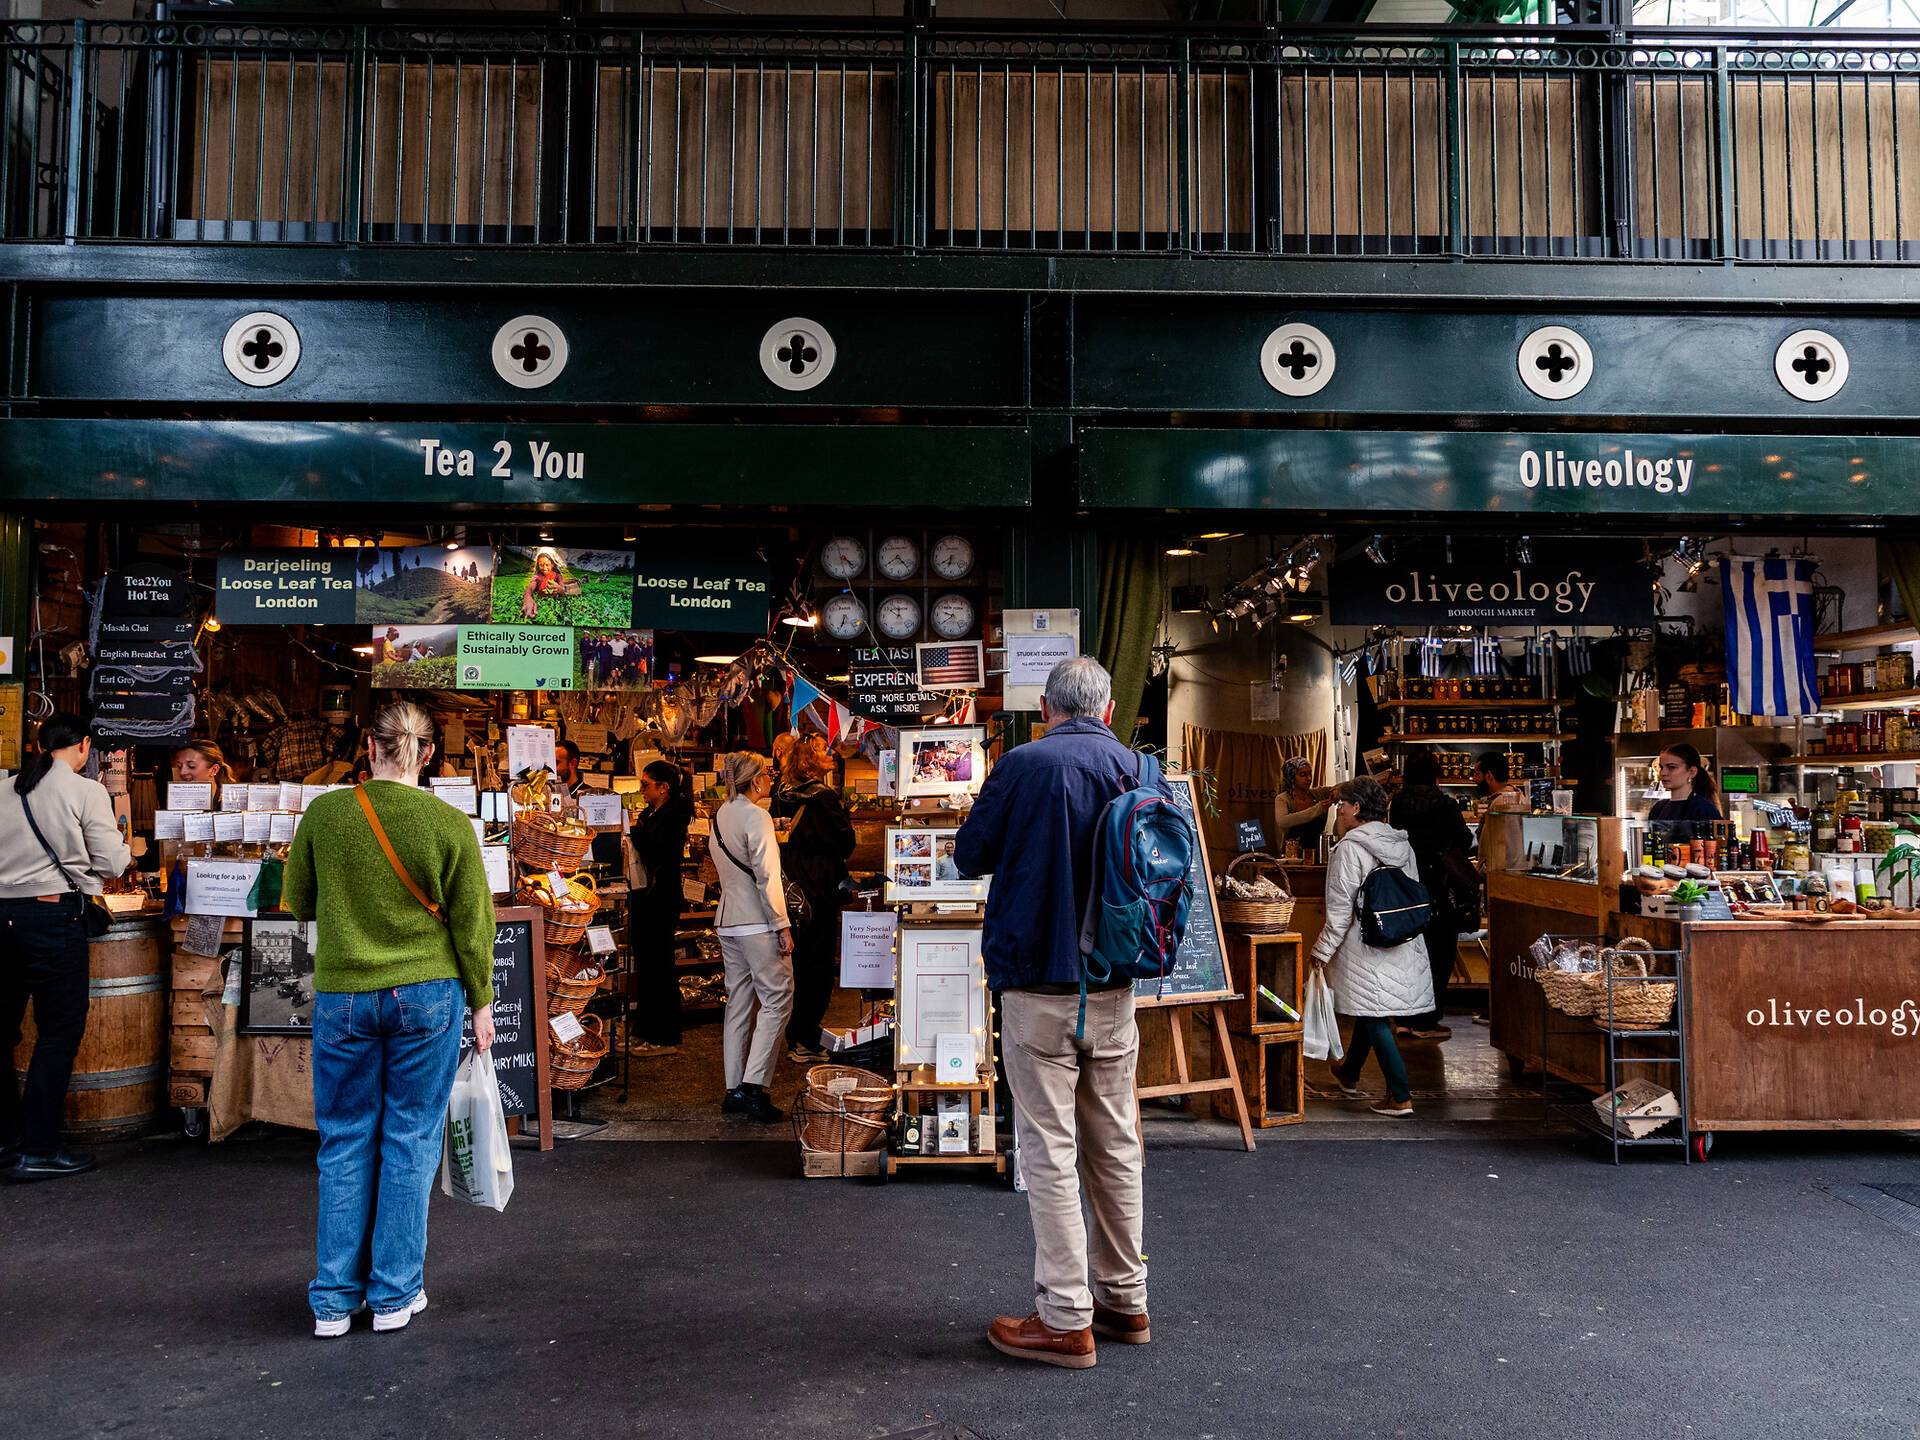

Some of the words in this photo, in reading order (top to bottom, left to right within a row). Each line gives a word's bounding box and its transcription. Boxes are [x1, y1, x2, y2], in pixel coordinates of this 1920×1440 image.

[420, 439, 474, 477] Tea
[491, 440, 513, 478] 2
[529, 441, 585, 479] You
[1519, 449, 1693, 493] Oliveology
[244, 559, 331, 574] Darjeeling
[124, 576, 172, 587] Tea2You
[221, 577, 273, 590] Loose
[278, 577, 317, 590] Leaf
[322, 577, 353, 590] Tea
[637, 574, 688, 588] Loose
[693, 577, 730, 590] Leaf
[735, 579, 766, 592] Tea
[127, 590, 148, 601] Hot
[149, 590, 169, 601] Tea
[1385, 570, 1596, 613] oliveology
[255, 595, 318, 608] London
[670, 594, 732, 609] London
[1448, 609, 1495, 617] BOROUGH
[1497, 608, 1536, 617] MARKET
[102, 623, 130, 632] Masala
[131, 623, 149, 632] Chai
[467, 631, 515, 643] Ethically
[518, 631, 566, 642] Sourced
[100, 649, 130, 660] English
[131, 649, 167, 659] Breakfast
[463, 644, 529, 656] Sustainably
[532, 645, 569, 655] Grown
[855, 647, 880, 661] TEA
[100, 675, 116, 684] Earl
[117, 675, 137, 687] Grey
[859, 694, 877, 703] FOR
[882, 693, 905, 702] MORE
[906, 692, 937, 701] DETAILS
[99, 702, 125, 710] Assam
[870, 705, 887, 713] ASK
[894, 704, 920, 713] INSIDE
[196, 872, 220, 880] Looking
[866, 925, 891, 933] Special
[1186, 959, 1198, 970] best
[1746, 998, 1920, 1036] oliveology
[493, 1056, 512, 1071] AIRY
